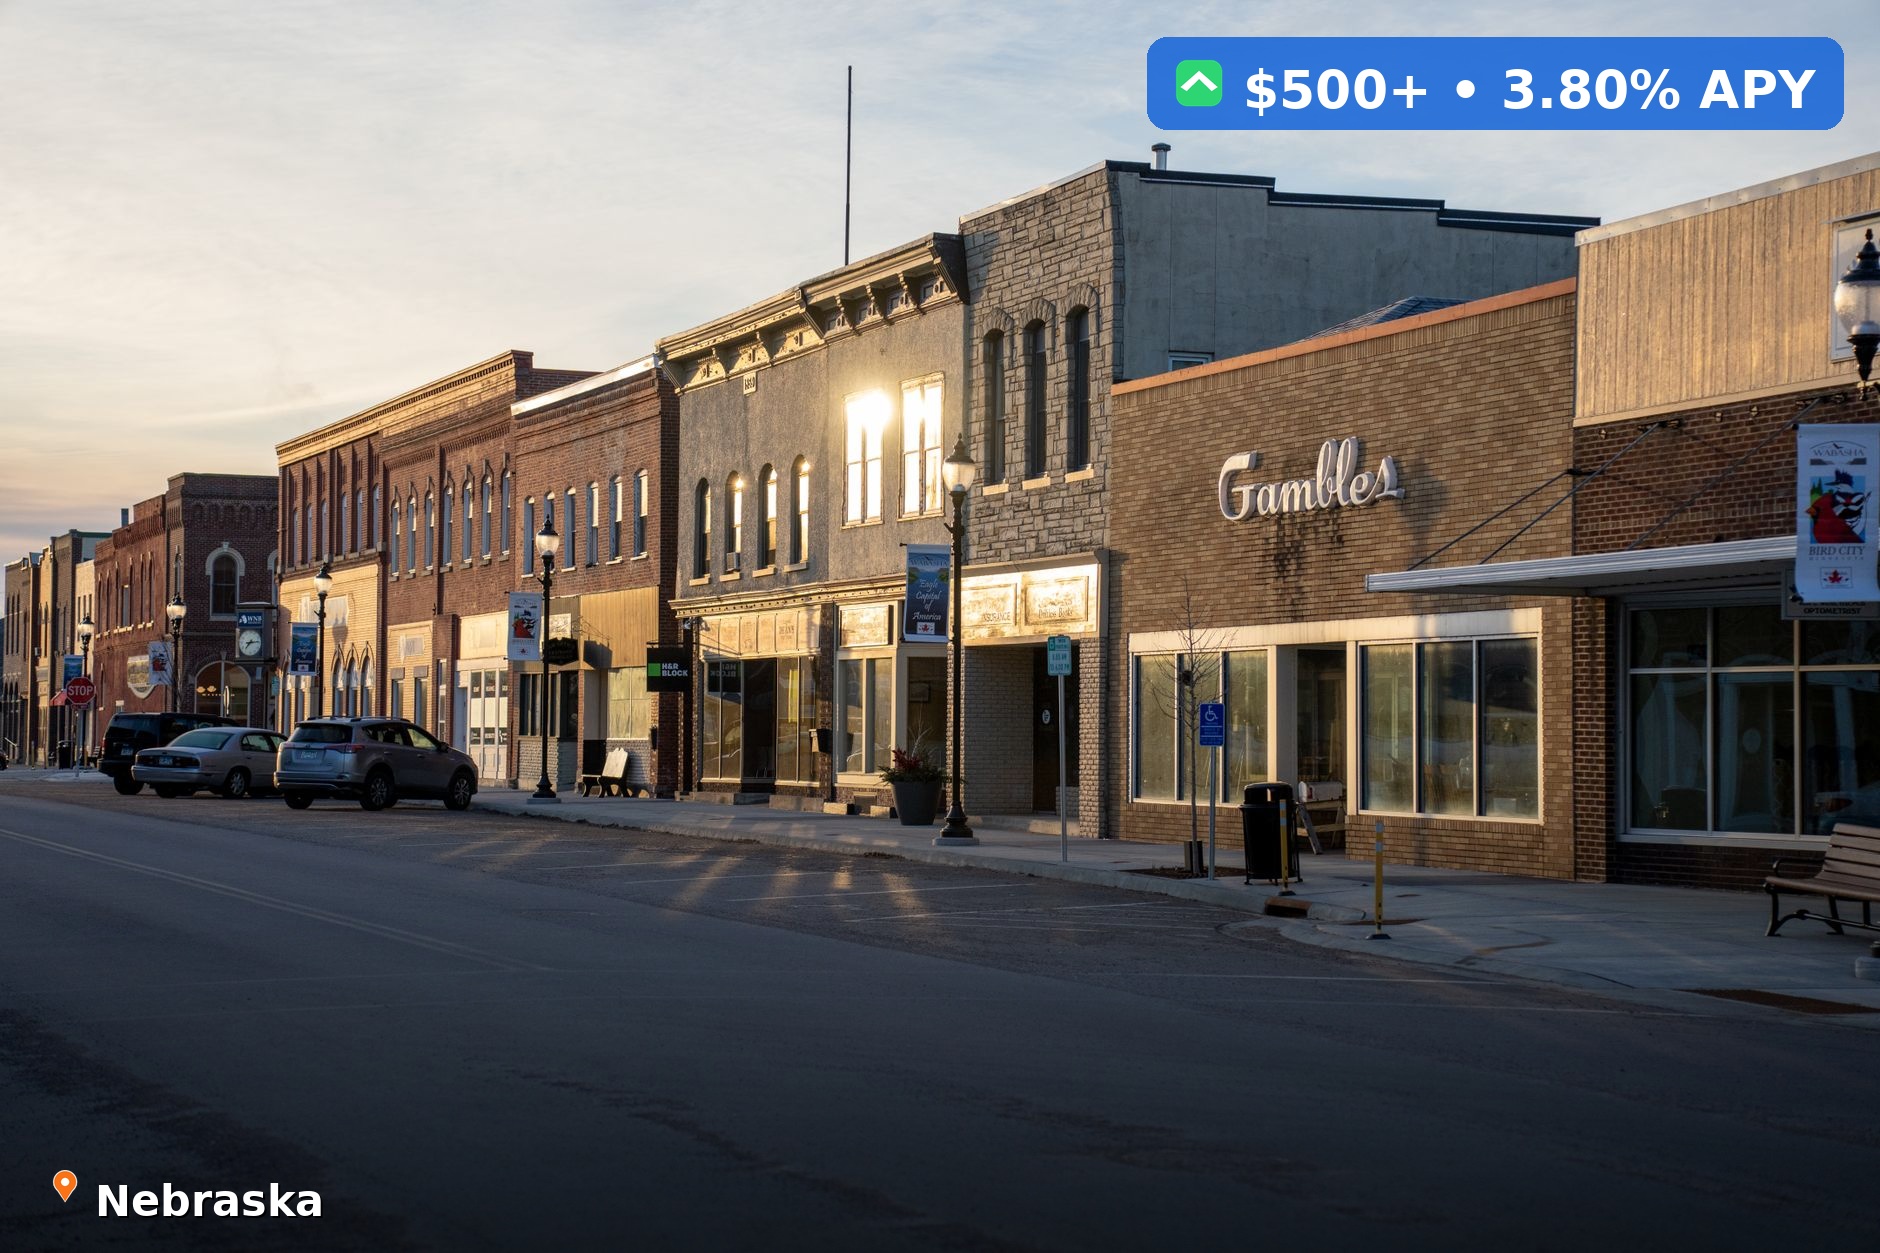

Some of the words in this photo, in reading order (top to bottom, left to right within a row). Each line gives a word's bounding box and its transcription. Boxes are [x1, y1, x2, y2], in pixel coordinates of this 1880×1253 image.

[1813, 448, 1865, 456] WABASHA
[1218, 436, 1406, 520] Gambles
[1808, 545, 1836, 556] BIRD
[1838, 545, 1866, 556] CITY
[919, 578, 938, 592] Eagle
[916, 590, 942, 603] Capital
[924, 600, 933, 612] of
[1803, 607, 1862, 615] OPTOMETRIST
[912, 611, 942, 621] America
[661, 662, 679, 670] H&R
[68, 685, 94, 696] STOP
